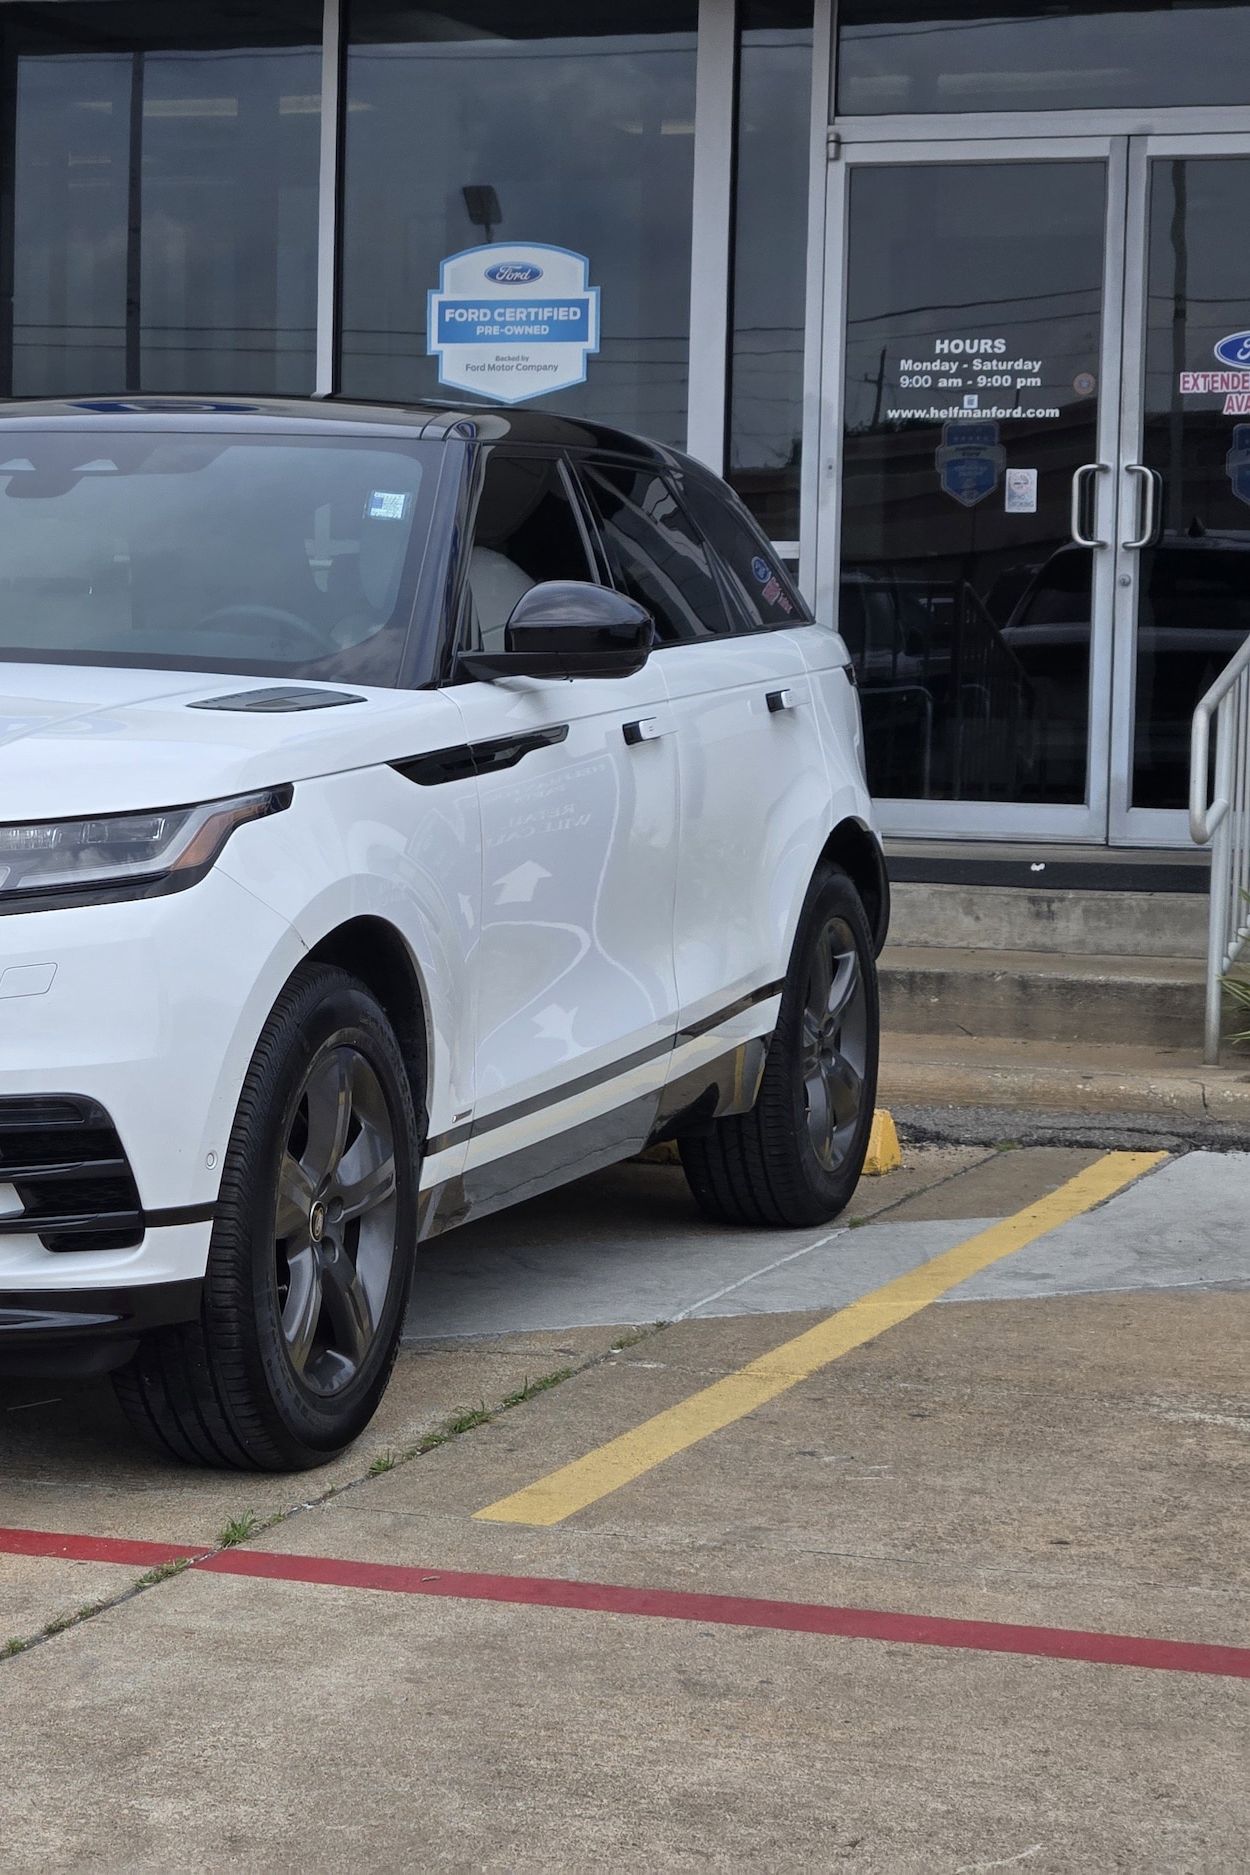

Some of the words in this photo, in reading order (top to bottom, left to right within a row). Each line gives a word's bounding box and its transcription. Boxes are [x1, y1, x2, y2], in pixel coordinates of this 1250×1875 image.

[496, 265, 531, 281] Ford
[445, 309, 491, 322] FORD
[493, 307, 581, 321] CERTIFIED
[476, 325, 549, 336] PRE-OWNED
[934, 339, 1006, 354] HOURS
[521, 355, 530, 363] by
[900, 359, 959, 373] Monday
[972, 358, 1042, 373] Saturday
[465, 363, 486, 372] Ford
[487, 363, 515, 372] Motor
[515, 362, 559, 374] Company
[900, 375, 932, 388] 9:00
[937, 377, 962, 387] am
[977, 375, 1012, 387] 9:00
[1016, 376, 1042, 389] pm
[887, 406, 1060, 419] www.helfmanford.com
